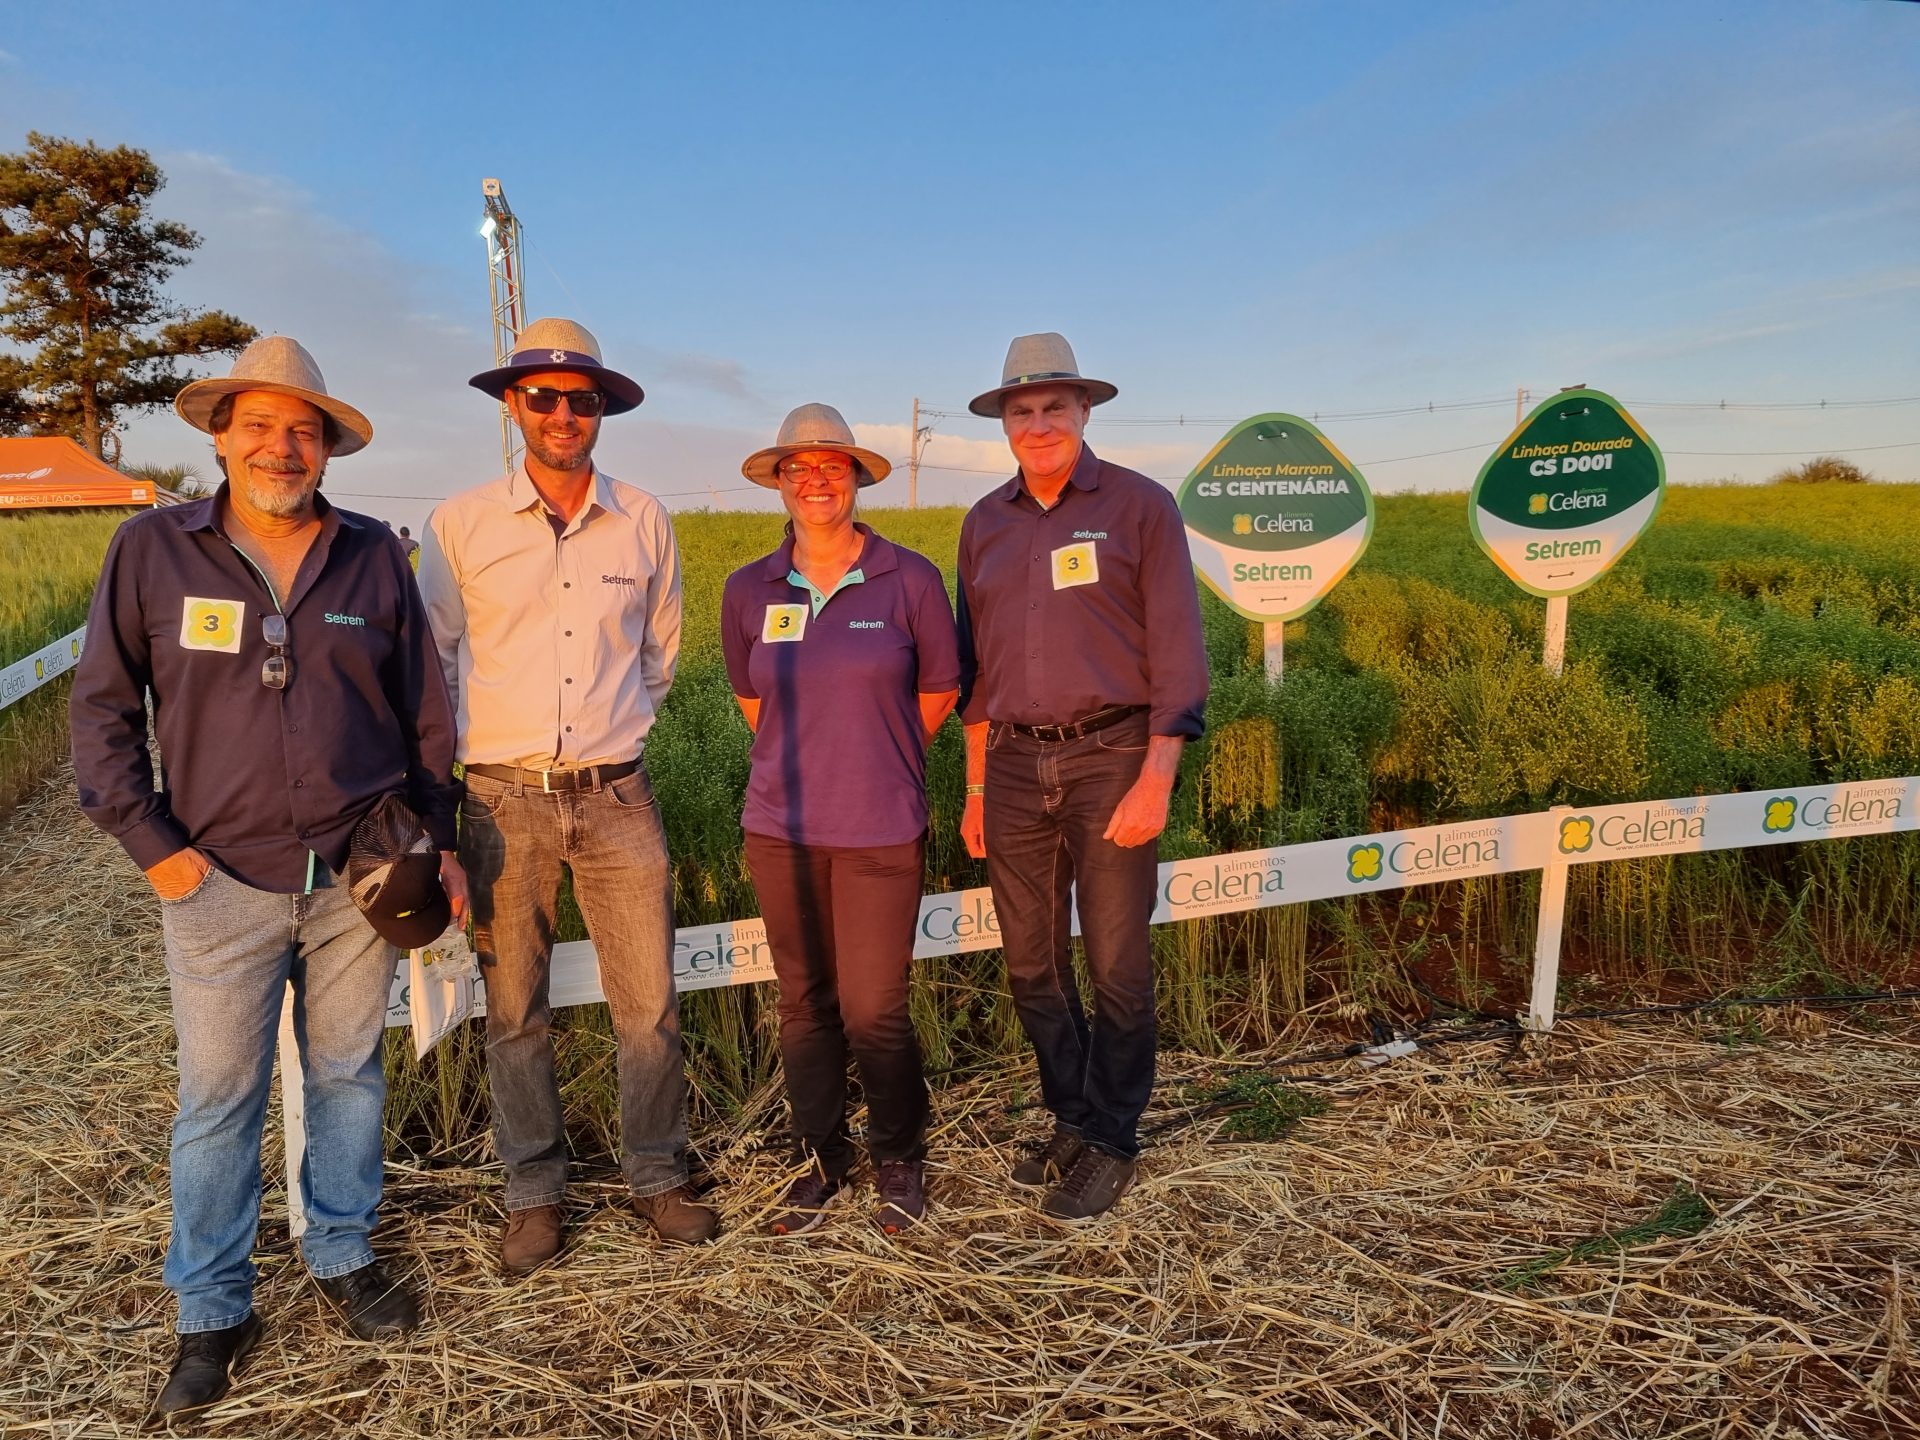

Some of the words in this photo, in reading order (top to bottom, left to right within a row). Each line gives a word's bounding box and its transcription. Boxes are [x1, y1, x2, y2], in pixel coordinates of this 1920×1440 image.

[1511, 444, 1568, 459] Linhaça
[1571, 436, 1633, 454] Dourada
[1212, 463, 1272, 478] Linhaça
[1275, 463, 1333, 476] Marrom
[1529, 458, 1557, 477] CS
[1562, 453, 1613, 474] D001
[1196, 482, 1222, 497] CS
[1226, 477, 1350, 497] CENTENÁRIA
[1549, 490, 1607, 512] Celena
[1253, 513, 1314, 533] Celena
[1524, 539, 1601, 562] Setrem
[1067, 557, 1079, 570] 3
[1232, 562, 1312, 582] Setrem
[601, 575, 636, 586] Setrem
[203, 615, 219, 632] 3
[779, 616, 790, 628] 3
[42, 652, 64, 675] Celena
[1, 673, 26, 698] Celena
[1853, 786, 1906, 799] alimentos
[1653, 805, 1710, 818] alimentos
[1801, 790, 1901, 827] Celena
[1444, 826, 1502, 842] alimentos
[1598, 809, 1705, 847] Celena
[1388, 834, 1500, 874] Celena
[1223, 856, 1286, 873] alimentos
[1164, 864, 1284, 906] Celena
[1184, 894, 1263, 910] www.celena.com.br
